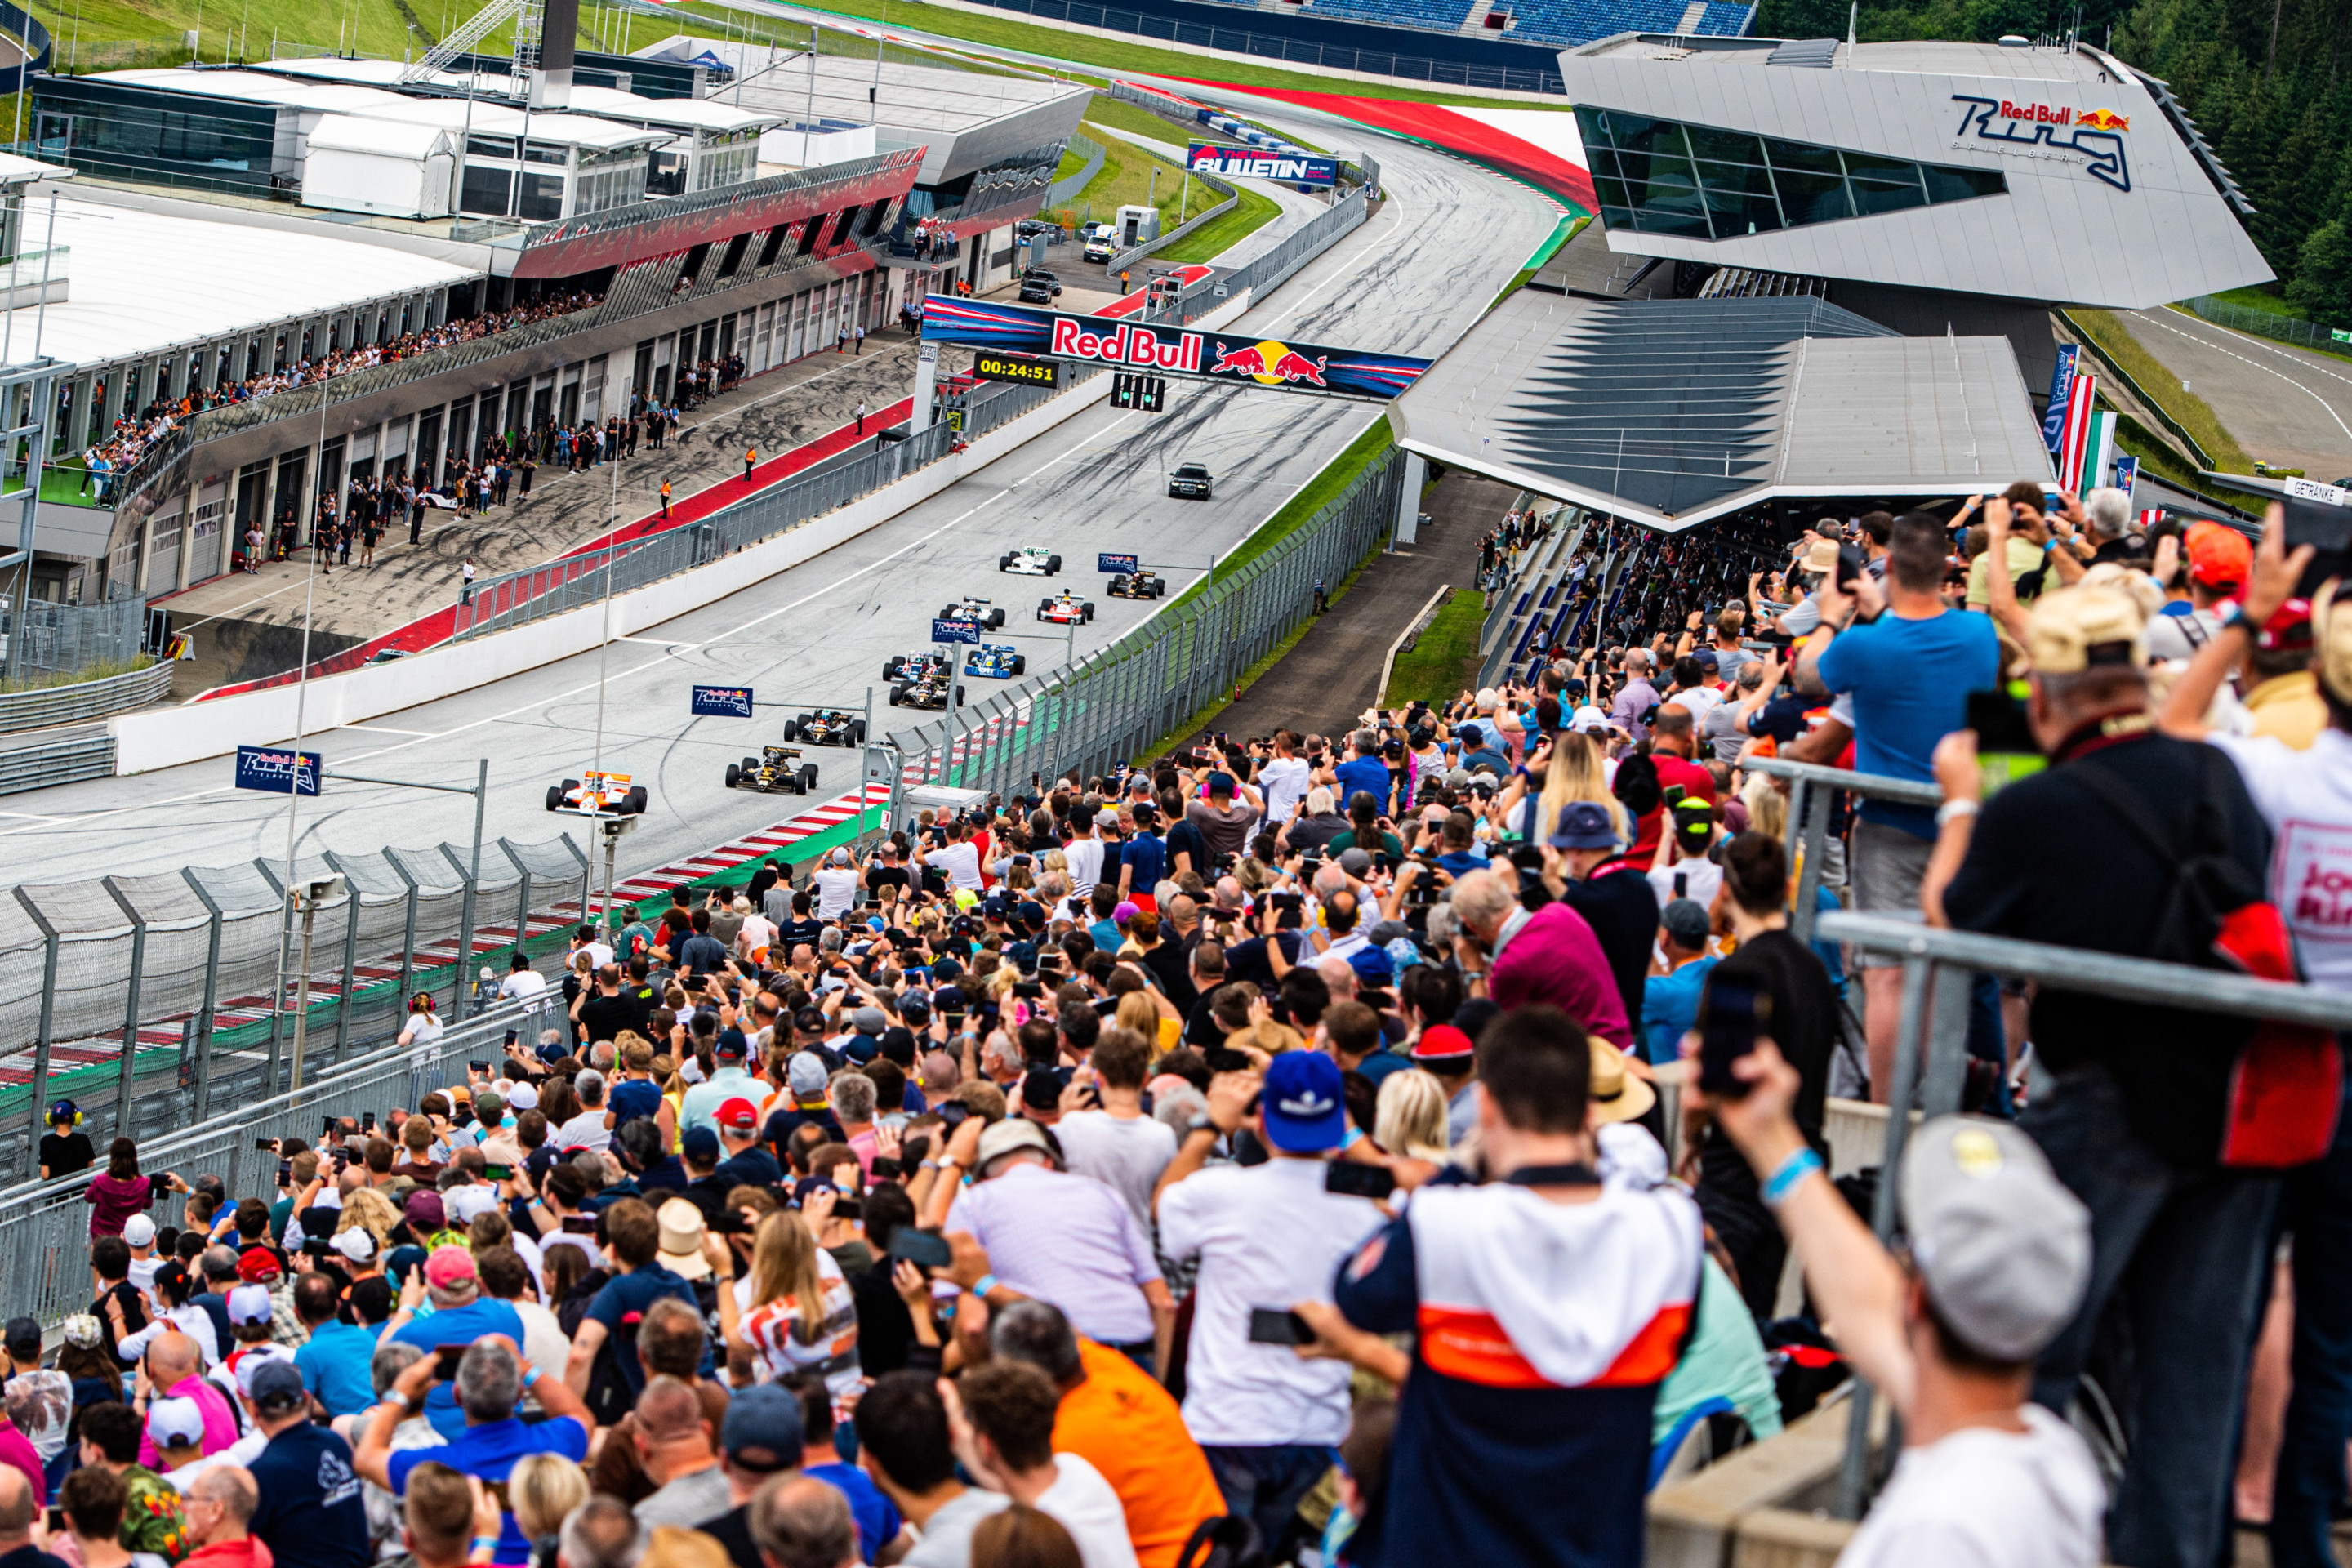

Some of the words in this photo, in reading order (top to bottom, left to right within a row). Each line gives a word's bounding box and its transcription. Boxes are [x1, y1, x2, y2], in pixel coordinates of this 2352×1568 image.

[2001, 100, 2036, 121] Red
[2037, 105, 2071, 125] Bull
[1223, 149, 1249, 159] THE
[1250, 151, 1279, 160] RED
[1950, 140, 2087, 164] SPIELBERG
[1052, 317, 1129, 362] Red
[1129, 326, 1204, 373] Bull
[980, 359, 1054, 381] 00:24:51
[2294, 481, 2335, 502] GETRÄNKE
[260, 753, 275, 763] Red
[275, 755, 290, 764] Bull
[242, 770, 296, 780] SPIELBER
[638, 987, 653, 999] 46
